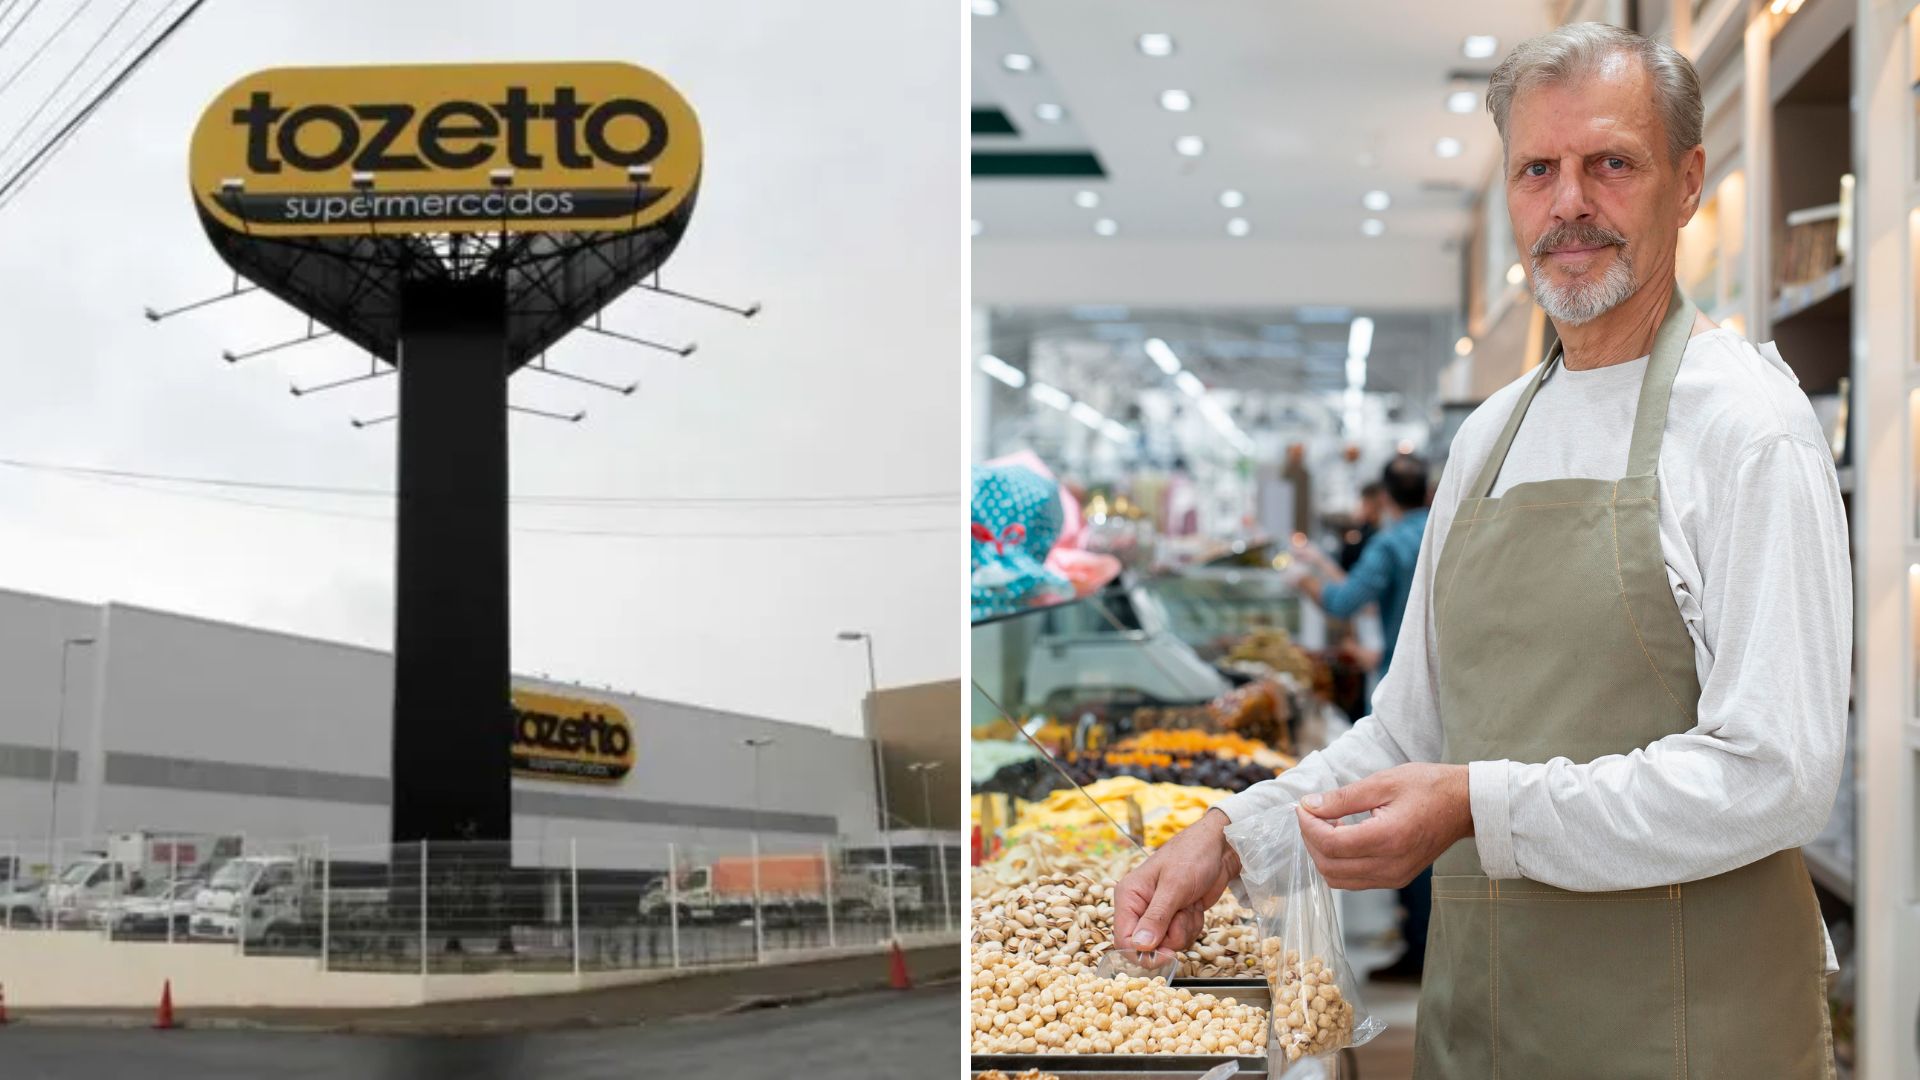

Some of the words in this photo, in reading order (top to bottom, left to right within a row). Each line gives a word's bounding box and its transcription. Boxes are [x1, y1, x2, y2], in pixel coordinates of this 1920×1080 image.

[232, 86, 669, 174] tozetto
[284, 188, 574, 224] supermercados
[512, 711, 631, 756] ozetto
